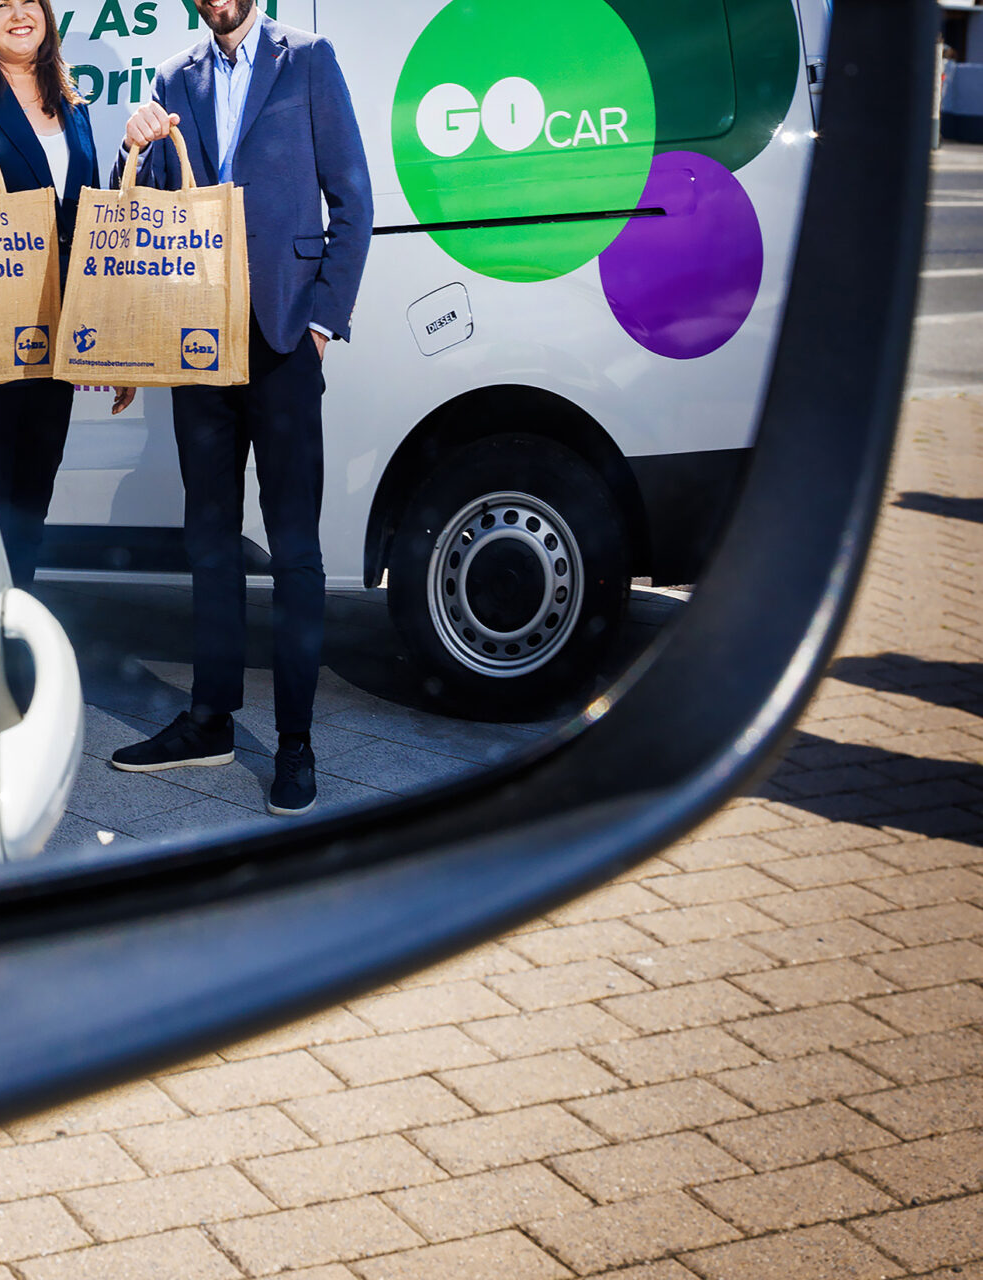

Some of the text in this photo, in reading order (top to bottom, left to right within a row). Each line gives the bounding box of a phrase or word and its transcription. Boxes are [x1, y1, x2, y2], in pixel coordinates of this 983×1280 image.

[94, 201, 187, 228] This Bag is
[89, 227, 223, 249] 100% Durable
[83, 256, 196, 276] & Reusable
[426, 311, 457, 334] DIESEL
